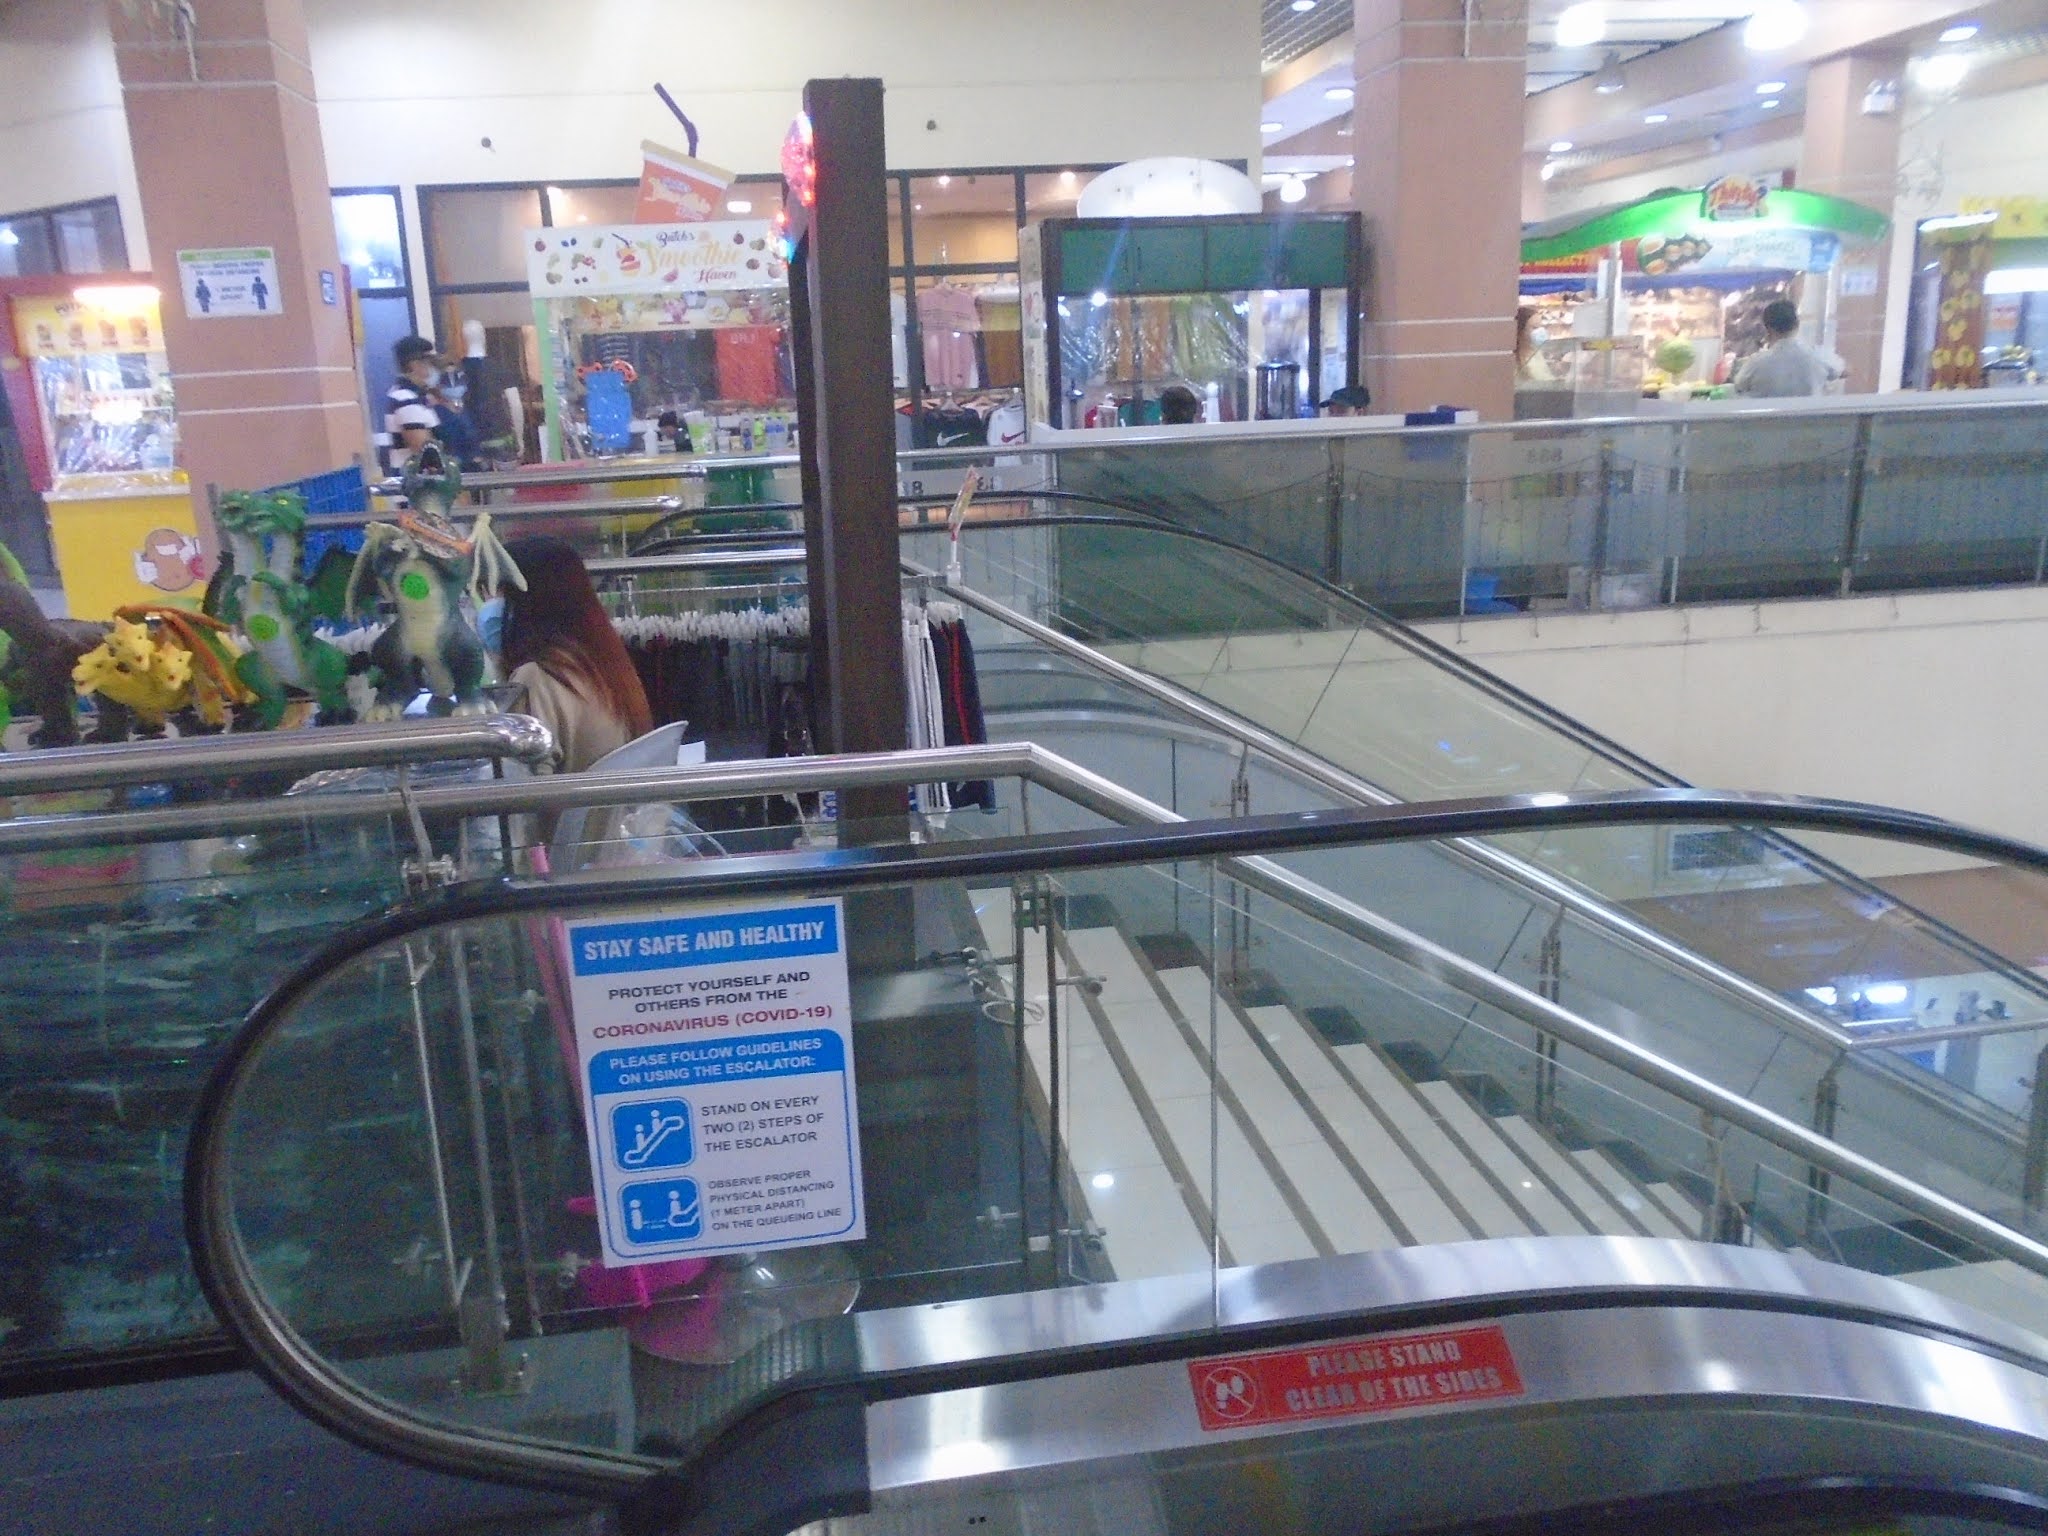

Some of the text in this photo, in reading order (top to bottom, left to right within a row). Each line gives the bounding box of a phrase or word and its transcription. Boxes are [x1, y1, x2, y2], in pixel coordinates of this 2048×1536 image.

[697, 268, 737, 284] Haven
[584, 921, 825, 961] STAY SAFE AND HEALTHY
[608, 971, 810, 1000] PROTECT YOURSELF AND
[635, 989, 788, 1013] OTHERS FROM THE
[592, 1005, 833, 1039] CORONAVIRUS (COVID-19)
[609, 1037, 822, 1069] PLEASE FOLLOW GUIDELINES
[618, 1055, 815, 1085] ON USING THE ESCALATOR:
[701, 1095, 819, 1116] STAND ON EVERY
[702, 1112, 824, 1135] TWO (2) STEPS OF
[704, 1131, 818, 1152] THE ESCALATOR
[708, 1169, 811, 1189] OBSERVE PROPER
[709, 1180, 835, 1203] PHYSICAL DISTANCING
[724, 1205, 762, 1216] METER
[764, 1198, 805, 1211] APART)
[712, 1208, 841, 1231] ON THE QUEUEING LINE
[1307, 1339, 1461, 1377] PLEASE STAND
[1285, 1367, 1503, 1412] CLEAR OF THE SIDES
